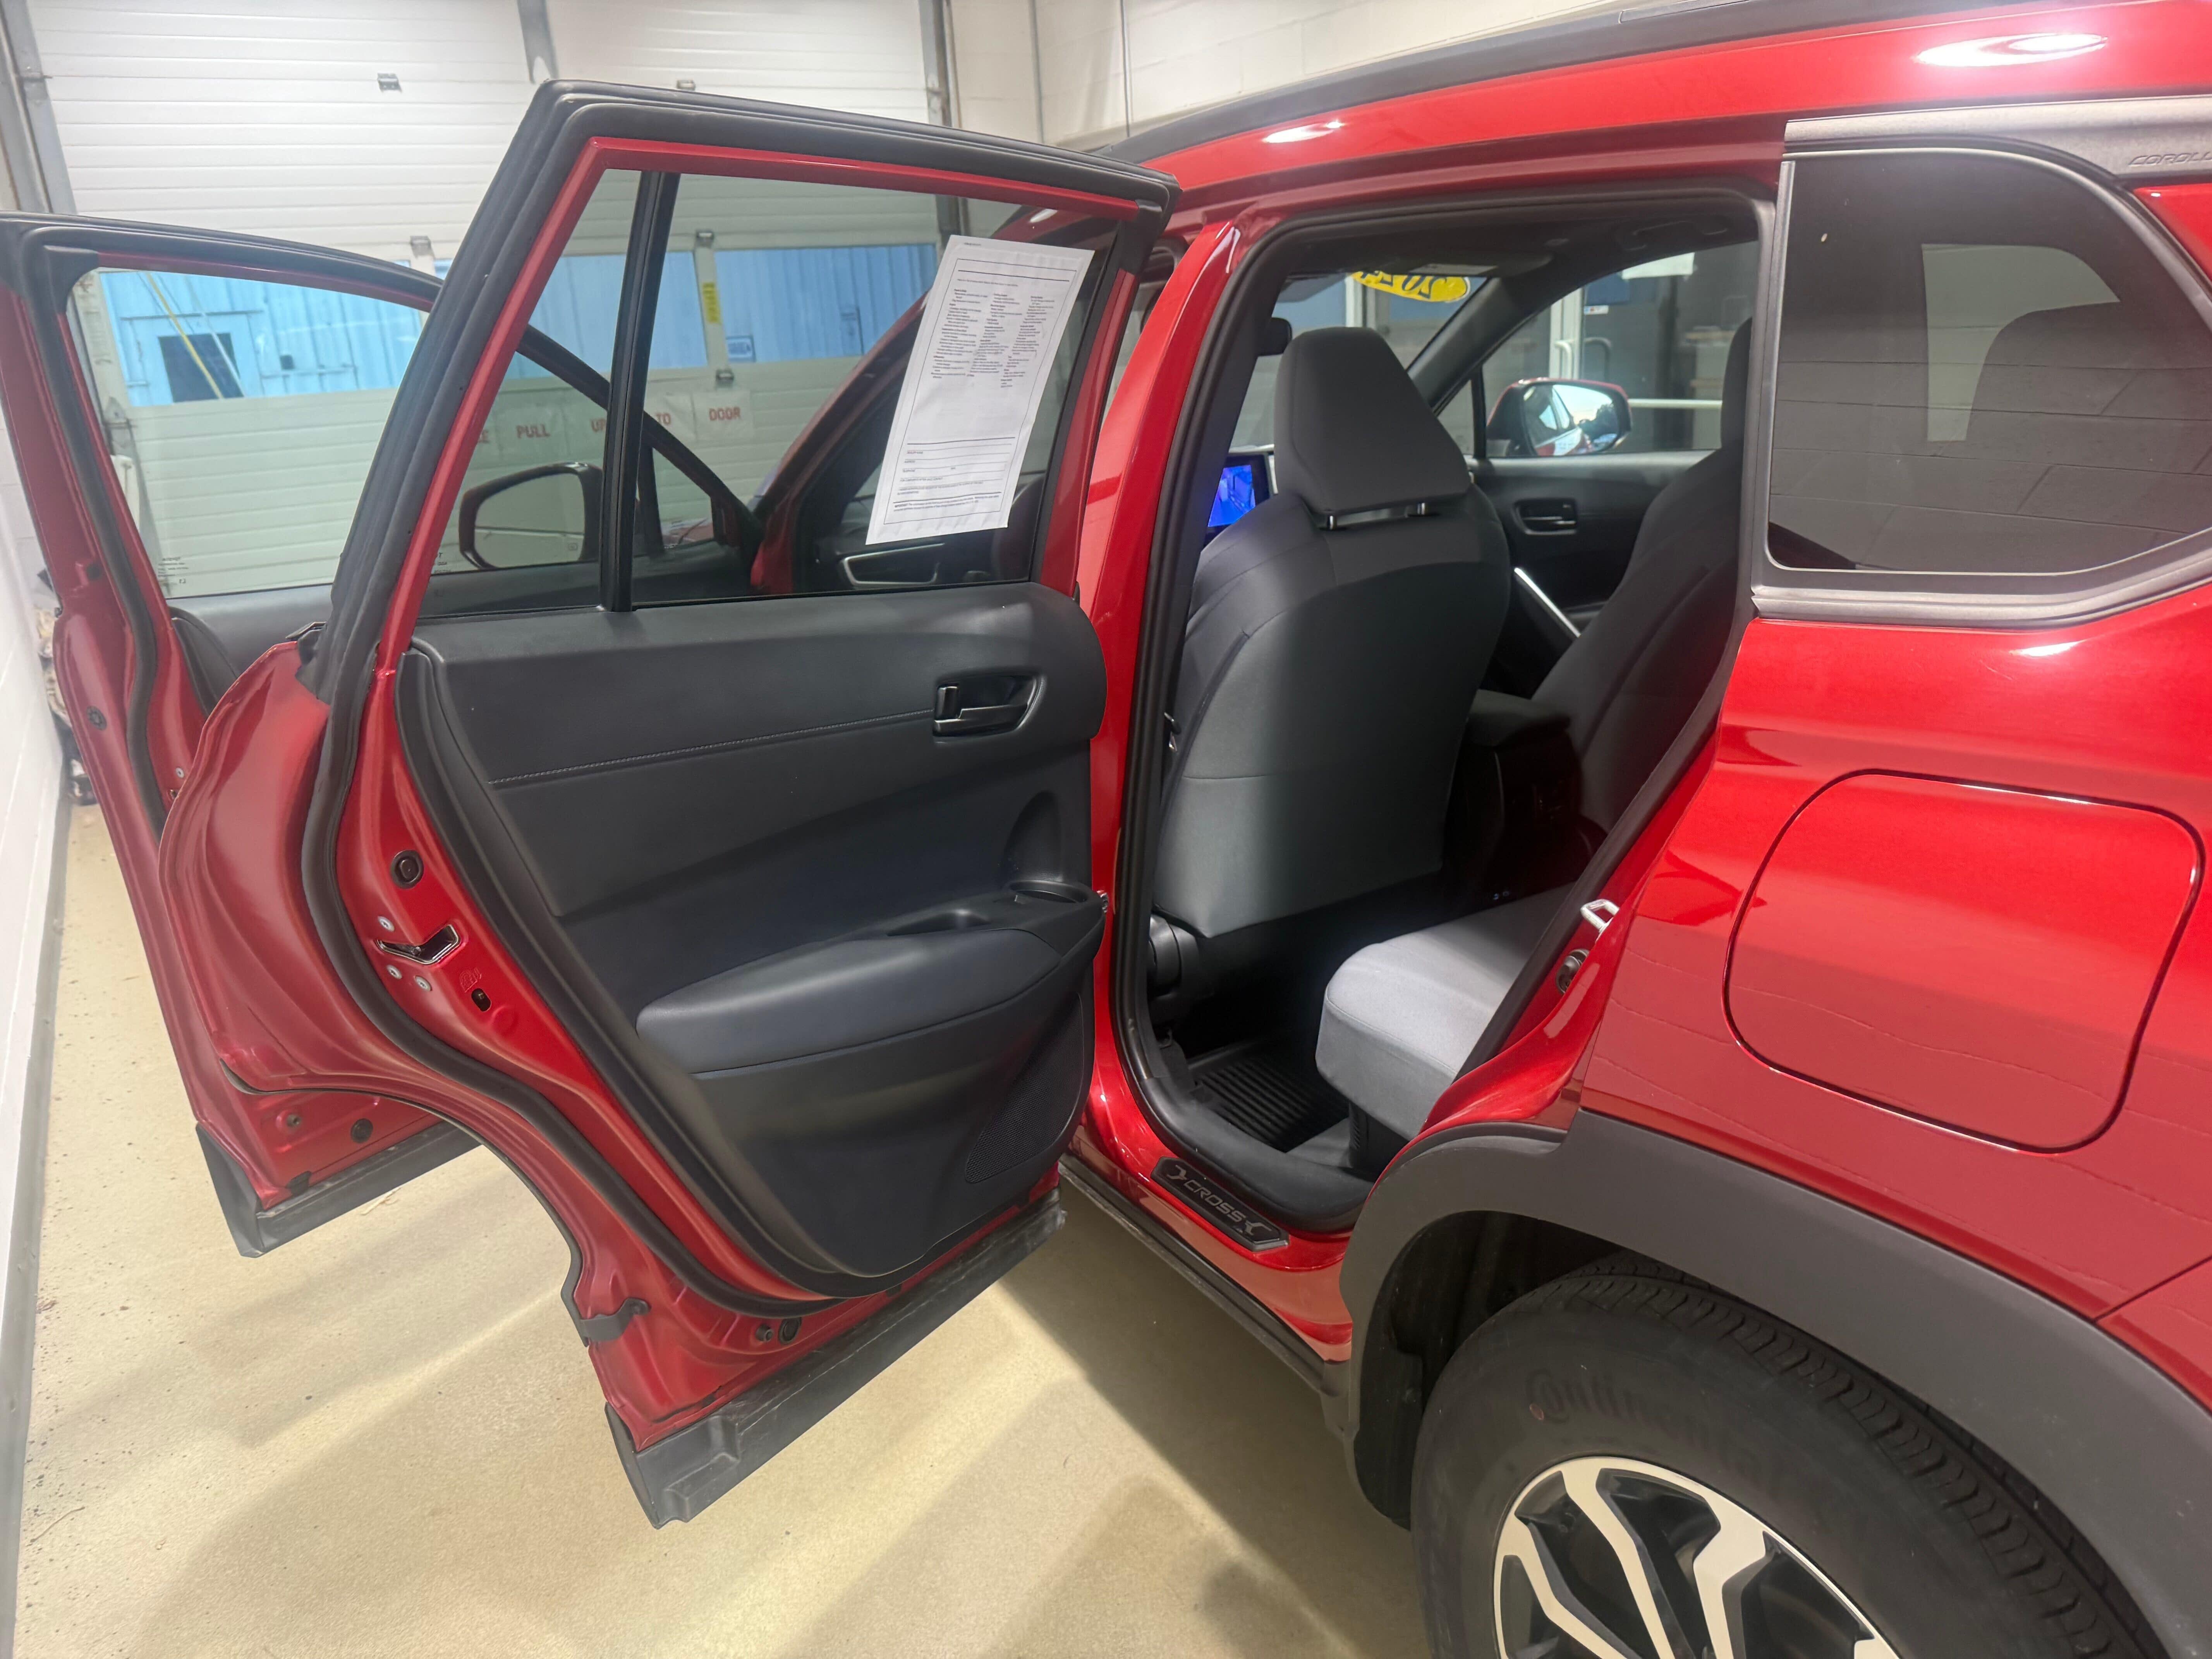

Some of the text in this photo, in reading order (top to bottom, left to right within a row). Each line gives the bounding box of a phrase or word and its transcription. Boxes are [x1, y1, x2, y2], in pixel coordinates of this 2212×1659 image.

[516, 424, 551, 438] PULL
[655, 412, 672, 426] TO
[709, 406, 741, 421] DOOR
[1183, 1179, 1246, 1223] CROSS
